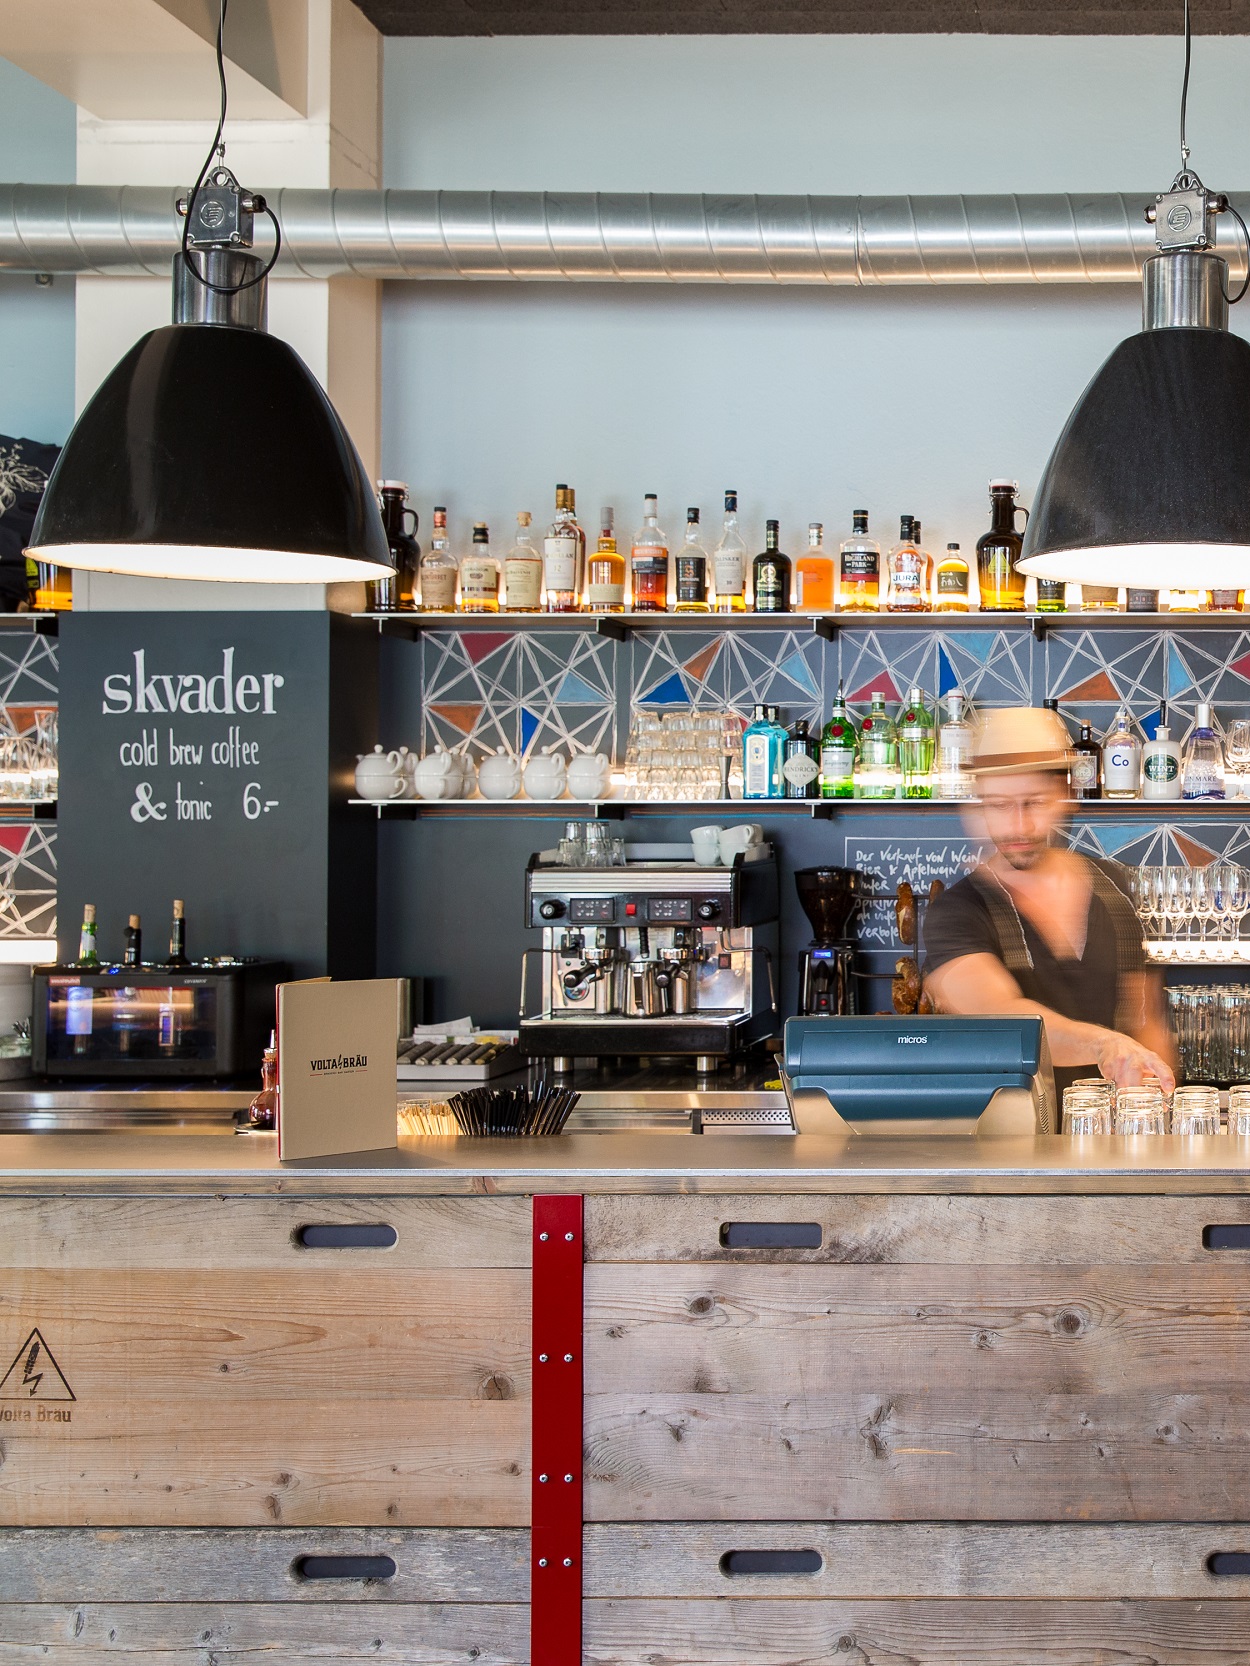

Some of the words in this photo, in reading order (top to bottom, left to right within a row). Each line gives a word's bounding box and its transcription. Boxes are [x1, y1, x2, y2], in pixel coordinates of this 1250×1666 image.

[844, 554, 875, 562] HIGHLAND
[893, 574, 918, 582] JURA
[102, 646, 285, 715] skvader
[120, 728, 158, 767] cold
[169, 727, 203, 765] brew
[211, 725, 260, 768] coffee
[1111, 754, 1130, 767] Co
[130, 782, 167, 823] &
[175, 781, 212, 821] tonic
[856, 850, 874, 862] Der
[897, 1035, 928, 1044] micros
[310, 1058, 338, 1071] VOLTA
[343, 1054, 368, 1068] BRÄU
